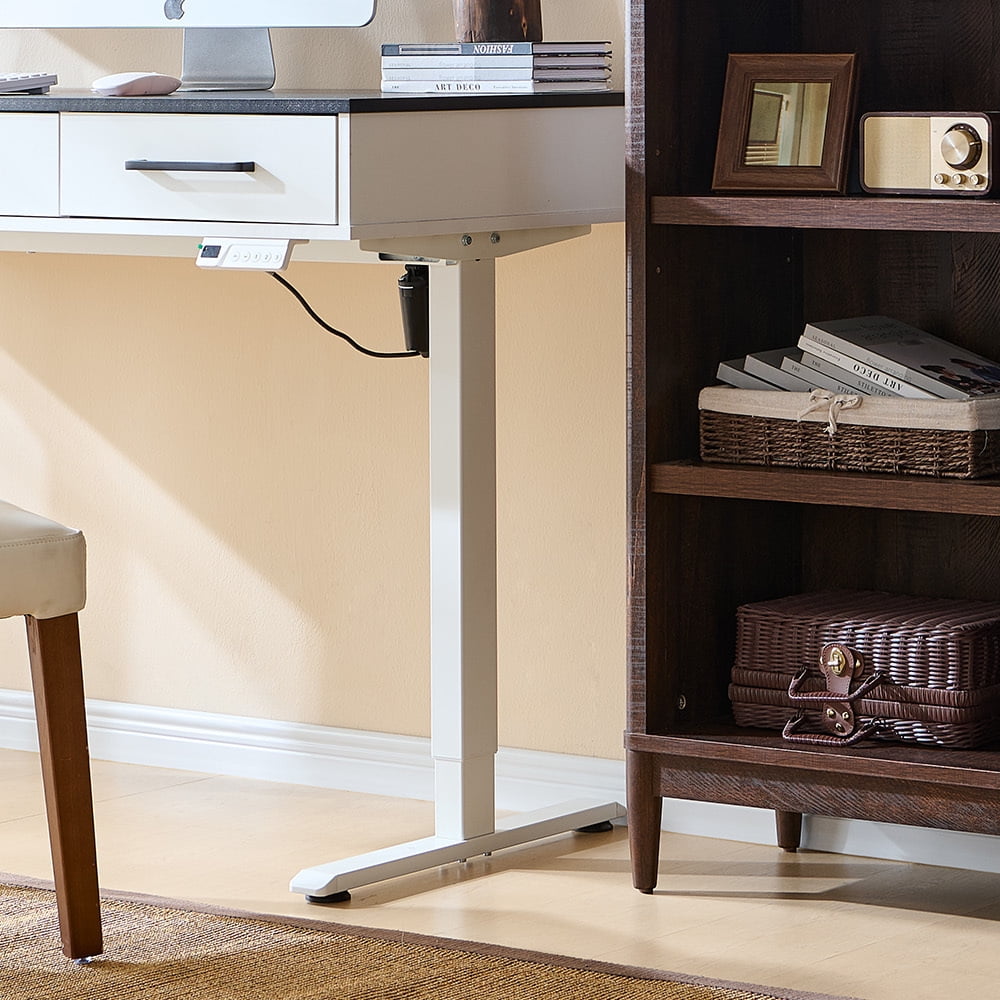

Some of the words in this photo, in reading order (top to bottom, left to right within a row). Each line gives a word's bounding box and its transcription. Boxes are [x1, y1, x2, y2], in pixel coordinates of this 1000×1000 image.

[473, 43, 514, 54] FASHION
[434, 83, 451, 91] ART
[456, 83, 481, 91] DECO
[853, 363, 880, 381] DECO
[882, 377, 903, 391] ART
